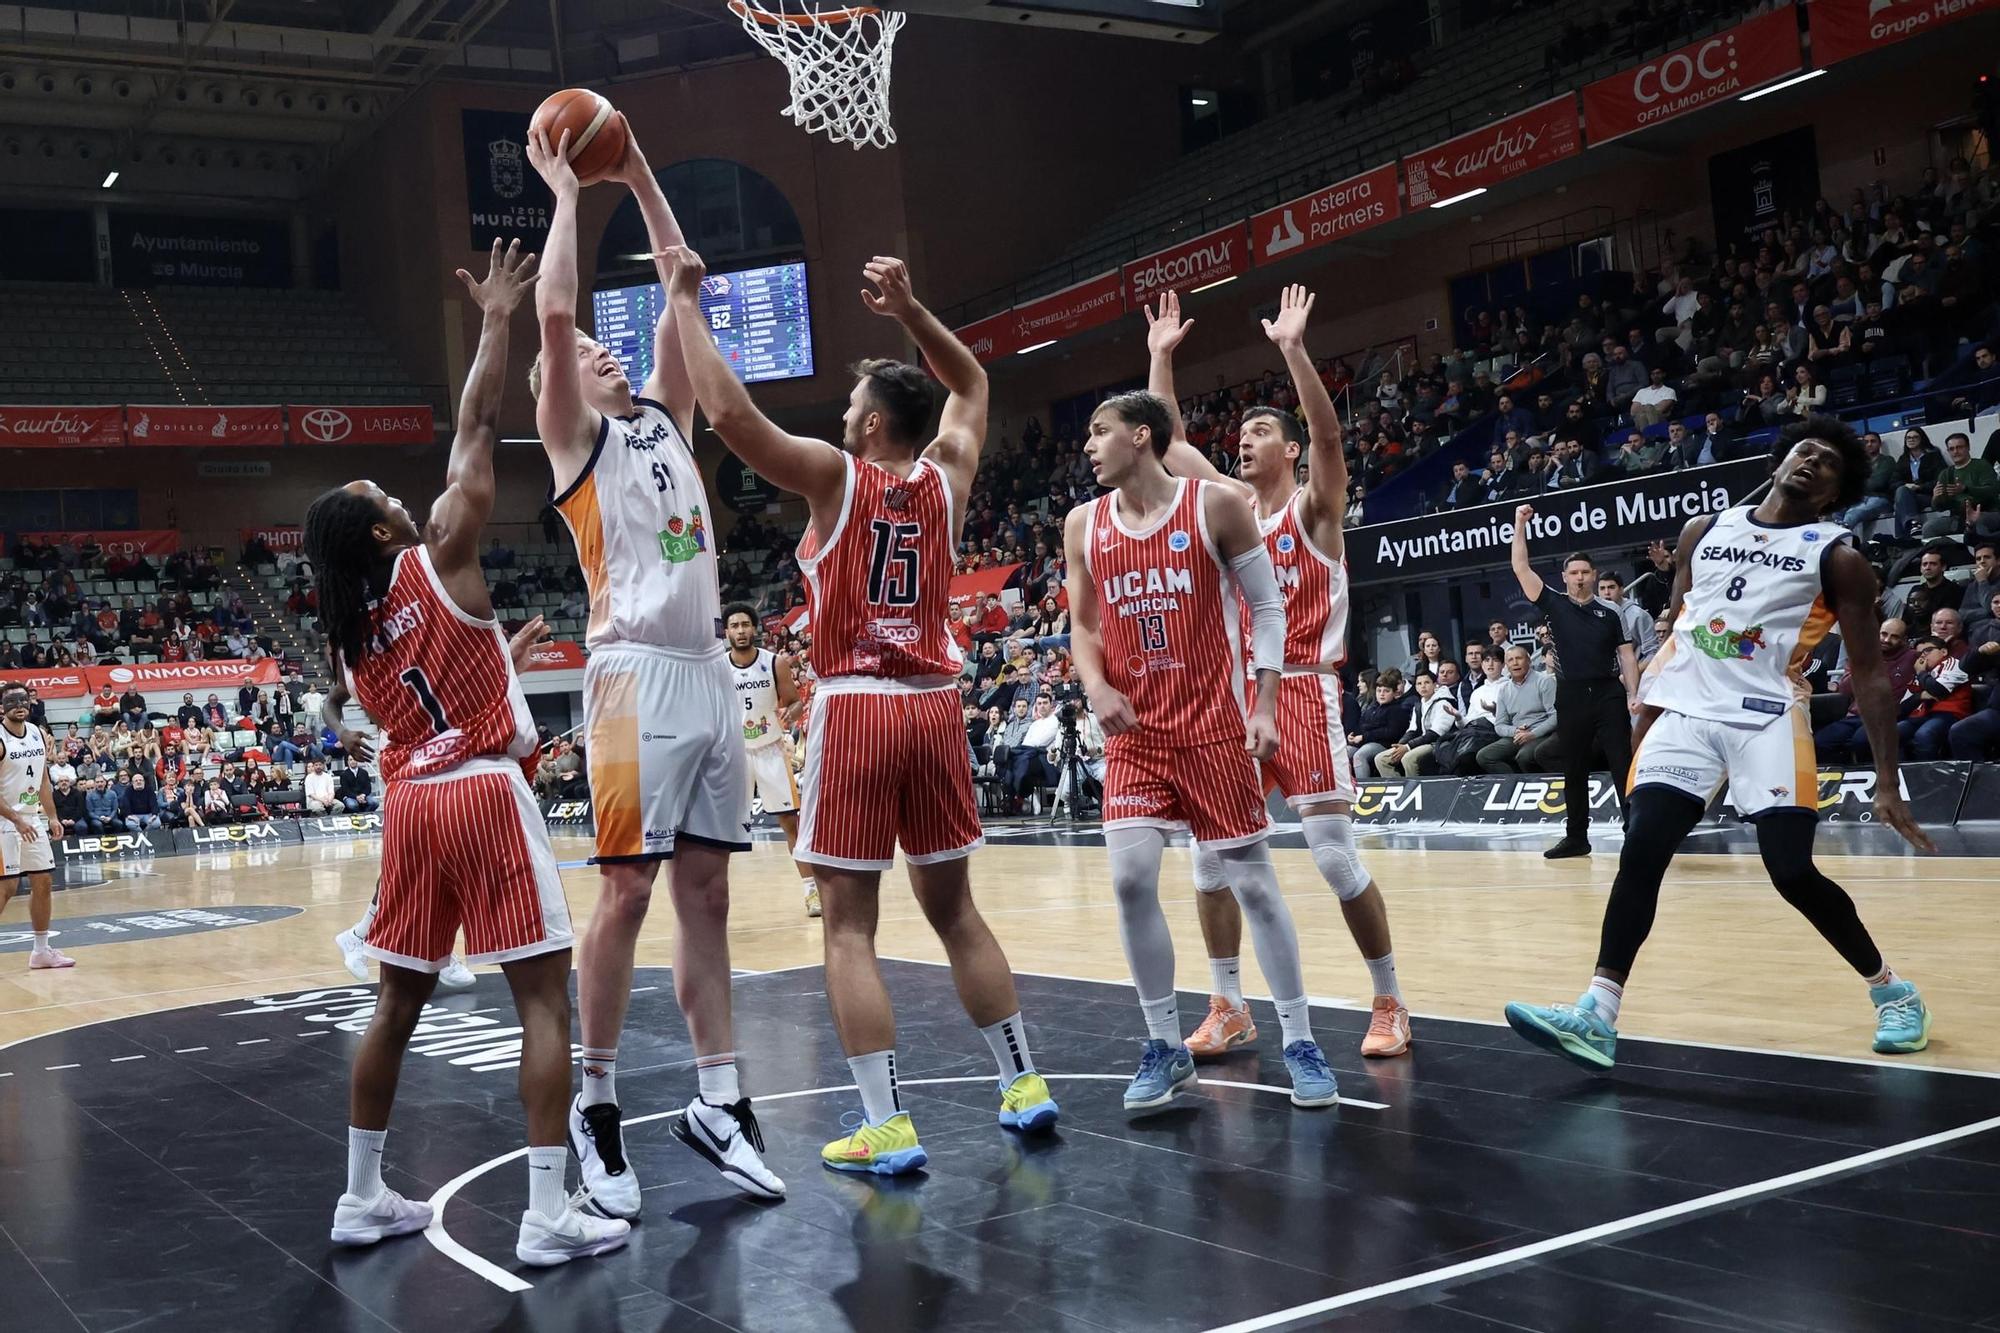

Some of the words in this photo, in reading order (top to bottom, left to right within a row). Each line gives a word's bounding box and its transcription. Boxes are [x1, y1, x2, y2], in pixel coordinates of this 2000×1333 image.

[1870, 11, 1930, 40] Grupo
[1309, 181, 1371, 217] Asterra
[472, 213, 549, 228] MURCIA
[510, 207, 545, 216] 1200
[1311, 201, 1384, 240] Partners
[131, 232, 261, 254] Ayuntamiento
[179, 260, 243, 279] Murcia
[1133, 239, 1232, 293] setcomur
[711, 312, 731, 329] 52
[1030, 309, 1071, 328] ESTRELLA
[1077, 291, 1115, 313] LEVANTE
[363, 417, 422, 432] LABASA
[1570, 502, 1607, 533] de
[1615, 482, 1730, 526] Murcia
[867, 518, 920, 607] 15
[1700, 546, 1806, 572] SEAWOLVES
[1103, 567, 1193, 605] UCAM
[1726, 576, 1747, 602] 8
[1118, 597, 1180, 619] MURCIA
[1136, 614, 1168, 652] 13
[1694, 631, 1739, 655] Karls
[735, 680, 770, 691] WOLVES
[400, 666, 450, 733] 1
[744, 697, 753, 711] 5
[10, 748, 44, 760] SEAWOLVES
[26, 765, 34, 778] 4
[547, 801, 590, 819] LIBERA
[193, 821, 280, 843] LIBERA
[317, 814, 384, 832] LIBER
[62, 833, 153, 854] LIBERA
[196, 838, 282, 849] TELECOM
[65, 849, 156, 861] TELECOM
